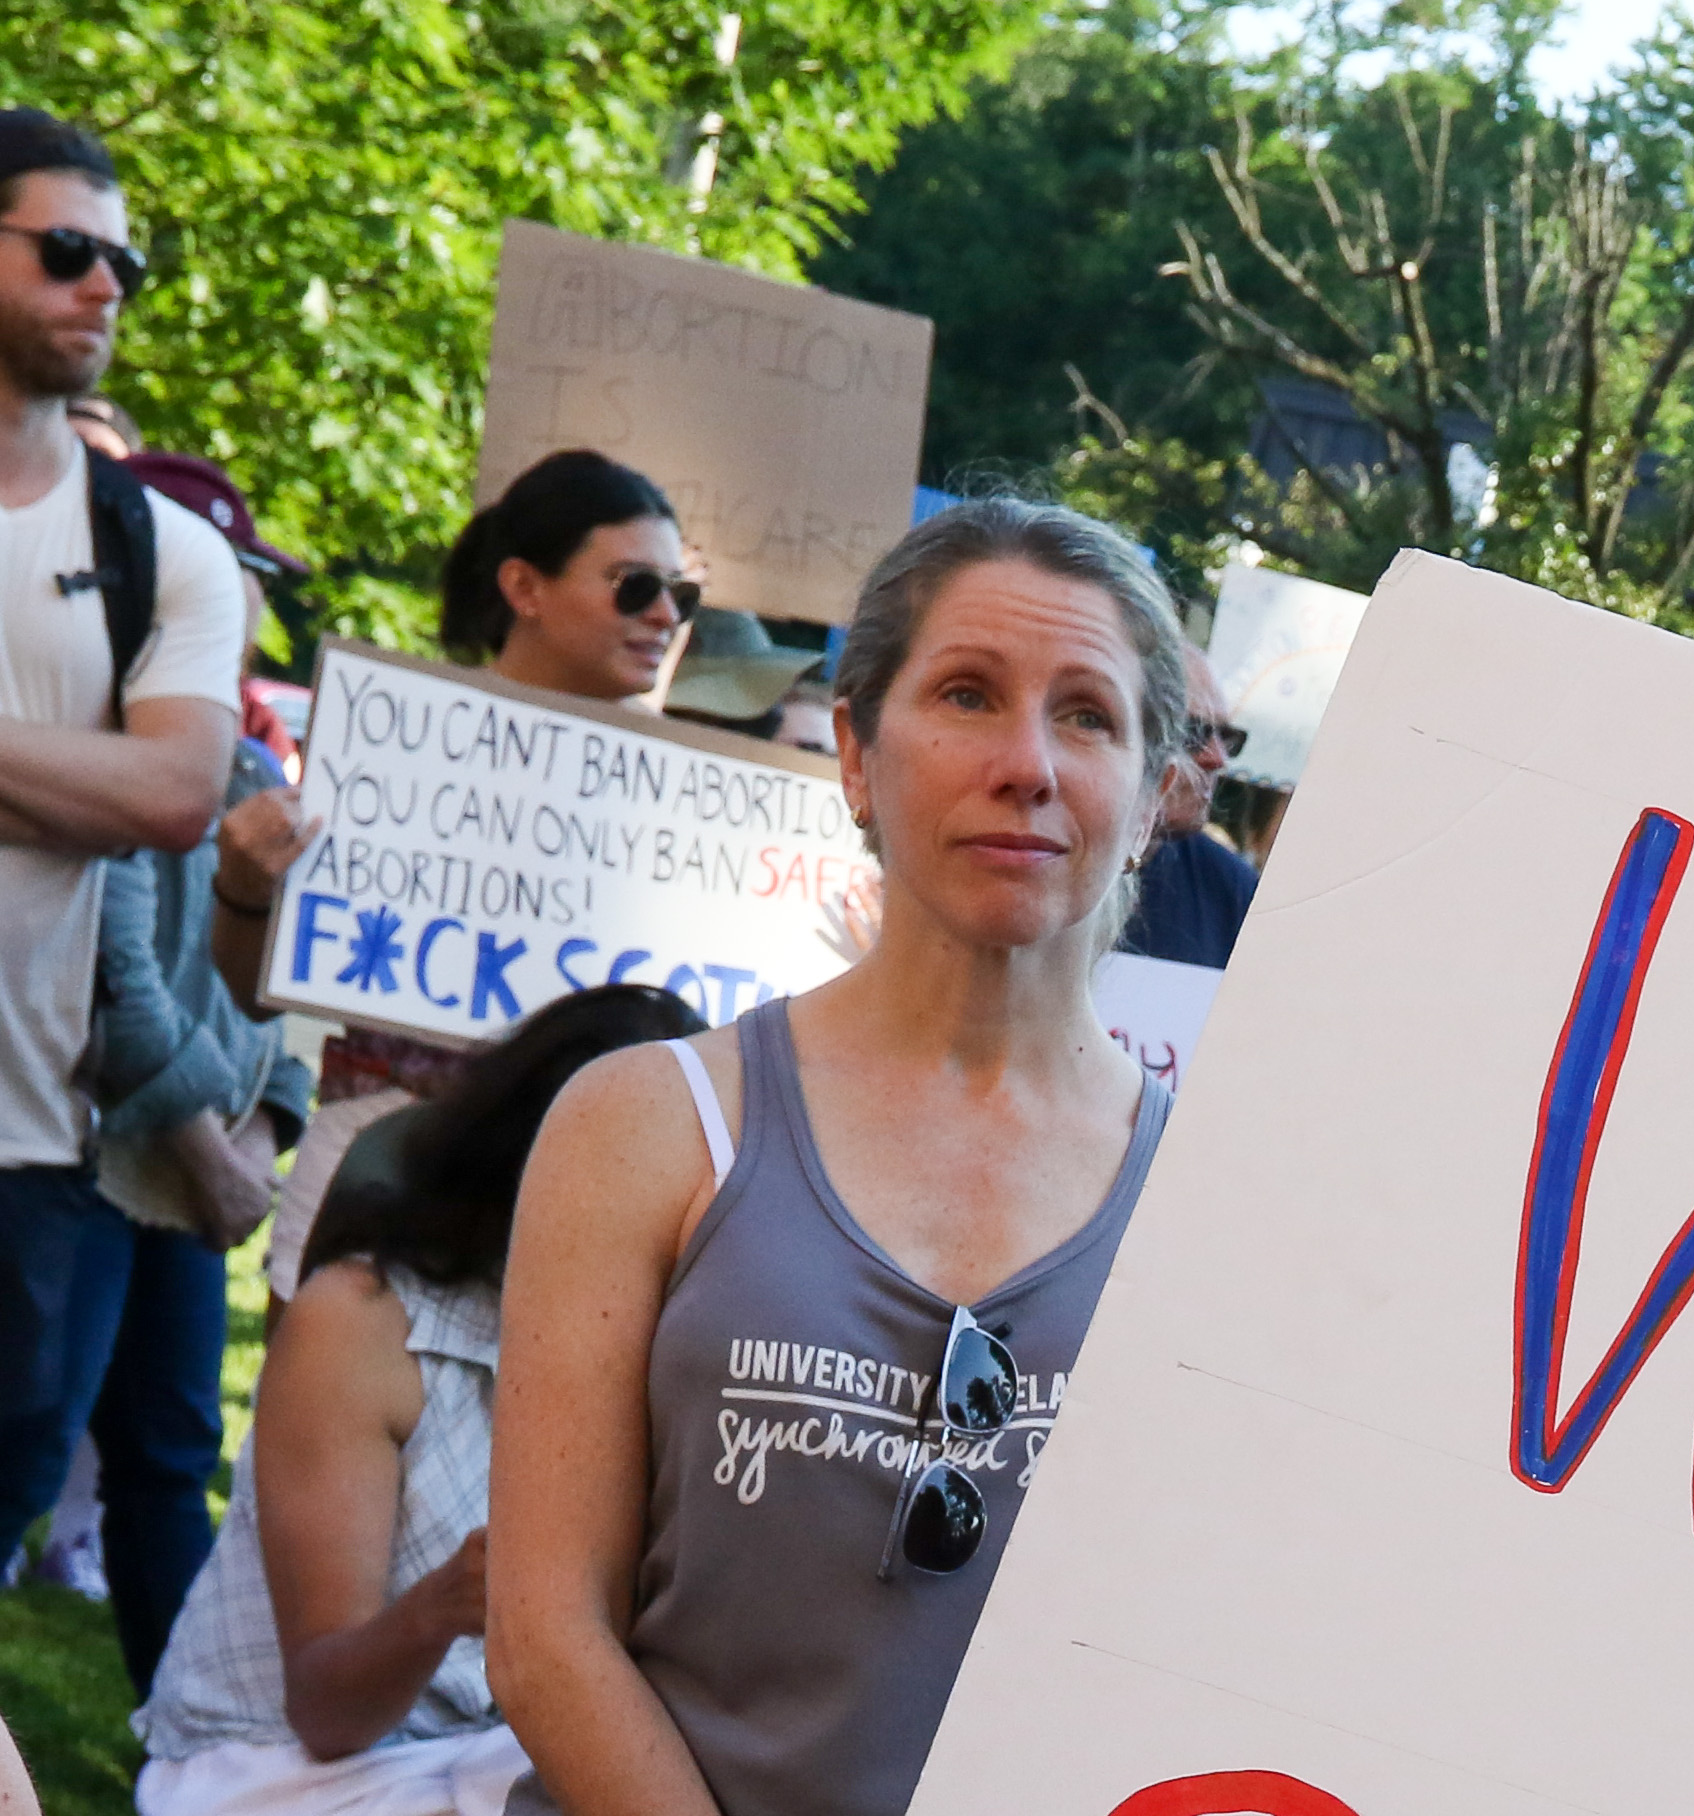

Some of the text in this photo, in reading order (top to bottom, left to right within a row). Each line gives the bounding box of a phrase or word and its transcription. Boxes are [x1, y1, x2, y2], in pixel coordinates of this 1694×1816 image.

[337, 669, 431, 755] YOU
[580, 737, 668, 803] BAN
[678, 752, 855, 846] ABORTIO
[306, 834, 594, 925] ABORTIONS!
[321, 757, 418, 832] YOU
[430, 783, 522, 847] CAN
[532, 805, 647, 876] ONLY
[653, 829, 748, 897] BAN
[728, 1338, 931, 1412] UNIVERSITY
